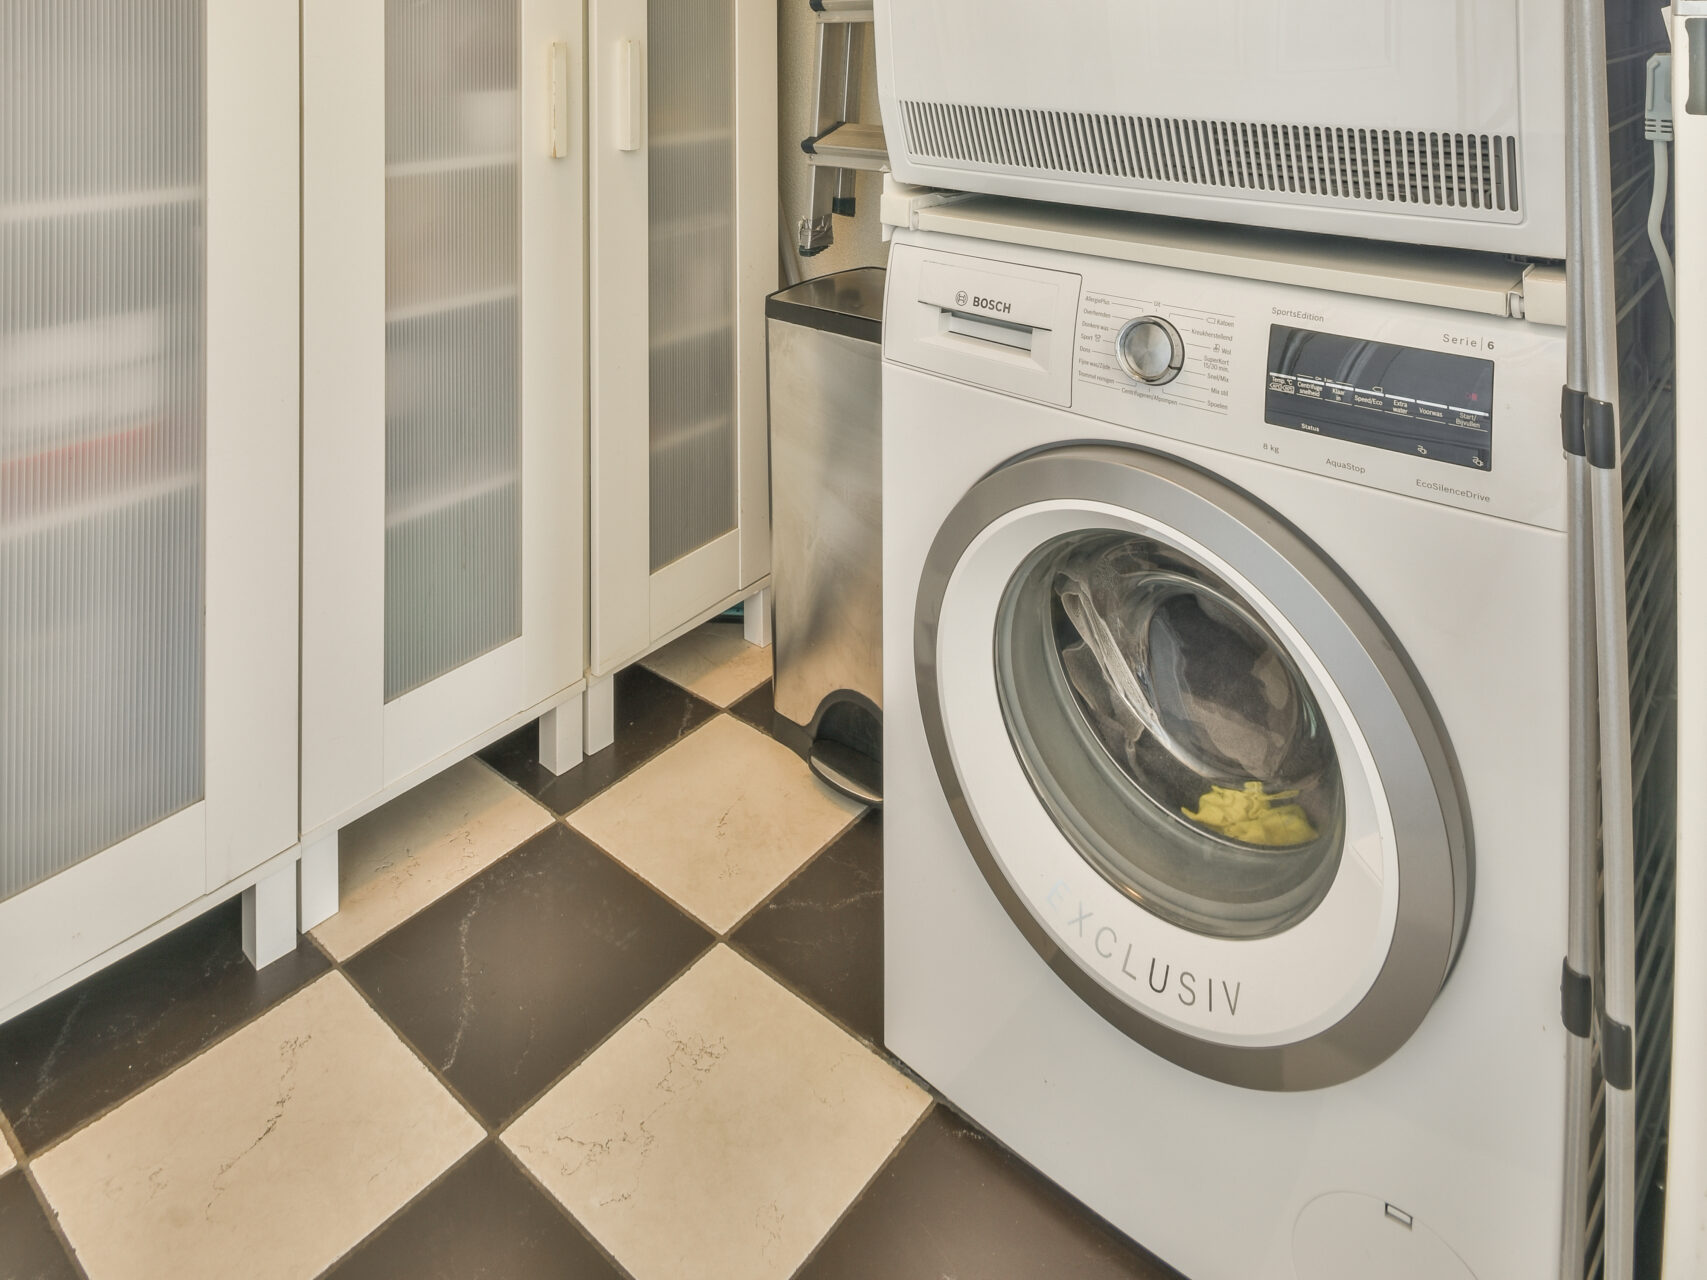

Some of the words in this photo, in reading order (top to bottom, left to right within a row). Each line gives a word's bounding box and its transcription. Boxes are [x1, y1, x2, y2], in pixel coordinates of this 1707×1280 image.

[972, 296, 1012, 314] BOSCH
[1272, 307, 1324, 323] SportsEdition
[1442, 333, 1477, 348] Serie
[1487, 341, 1495, 350] 6
[1298, 381, 1323, 392] Centrifuge
[1354, 395, 1383, 406] Speed/Eco
[1393, 399, 1408, 408] Extra
[1419, 407, 1443, 418] Voorwas
[1459, 412, 1477, 421] Start/
[1302, 423, 1320, 432] Status
[1263, 442, 1269, 450] 8
[1270, 444, 1280, 455] kg
[1325, 458, 1366, 475] AquaStop
[1416, 478, 1491, 503] EcoSilenceDrive
[1046, 879, 1241, 1016] EXCLUSIV
